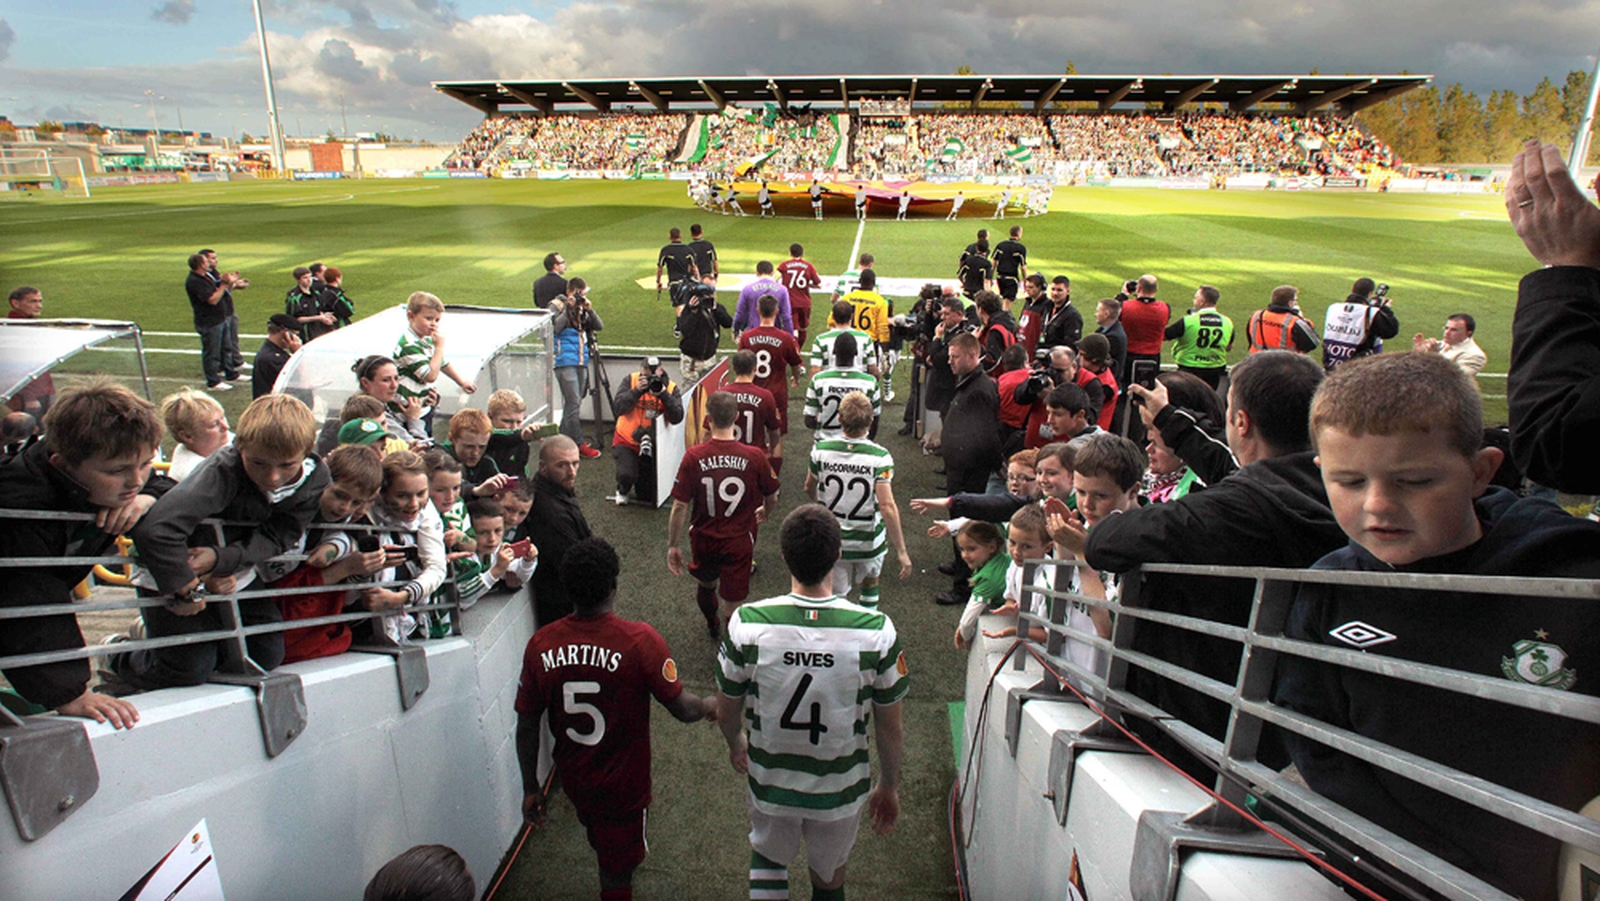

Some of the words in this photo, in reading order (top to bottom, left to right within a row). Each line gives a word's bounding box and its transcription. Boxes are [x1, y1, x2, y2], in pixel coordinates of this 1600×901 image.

[786, 270, 808, 289] 76
[850, 304, 872, 331] 16
[1196, 328, 1223, 349] 82
[755, 349, 772, 379] 8
[732, 393, 763, 408] DENIZ
[698, 454, 750, 472] KALESHIN
[822, 462, 872, 475] McCORMACK
[701, 475, 746, 518] 19
[824, 474, 873, 522] 22
[540, 644, 623, 673] MARTINS
[783, 651, 835, 669] SIVES
[562, 680, 606, 747] 5
[780, 672, 828, 746] 4
